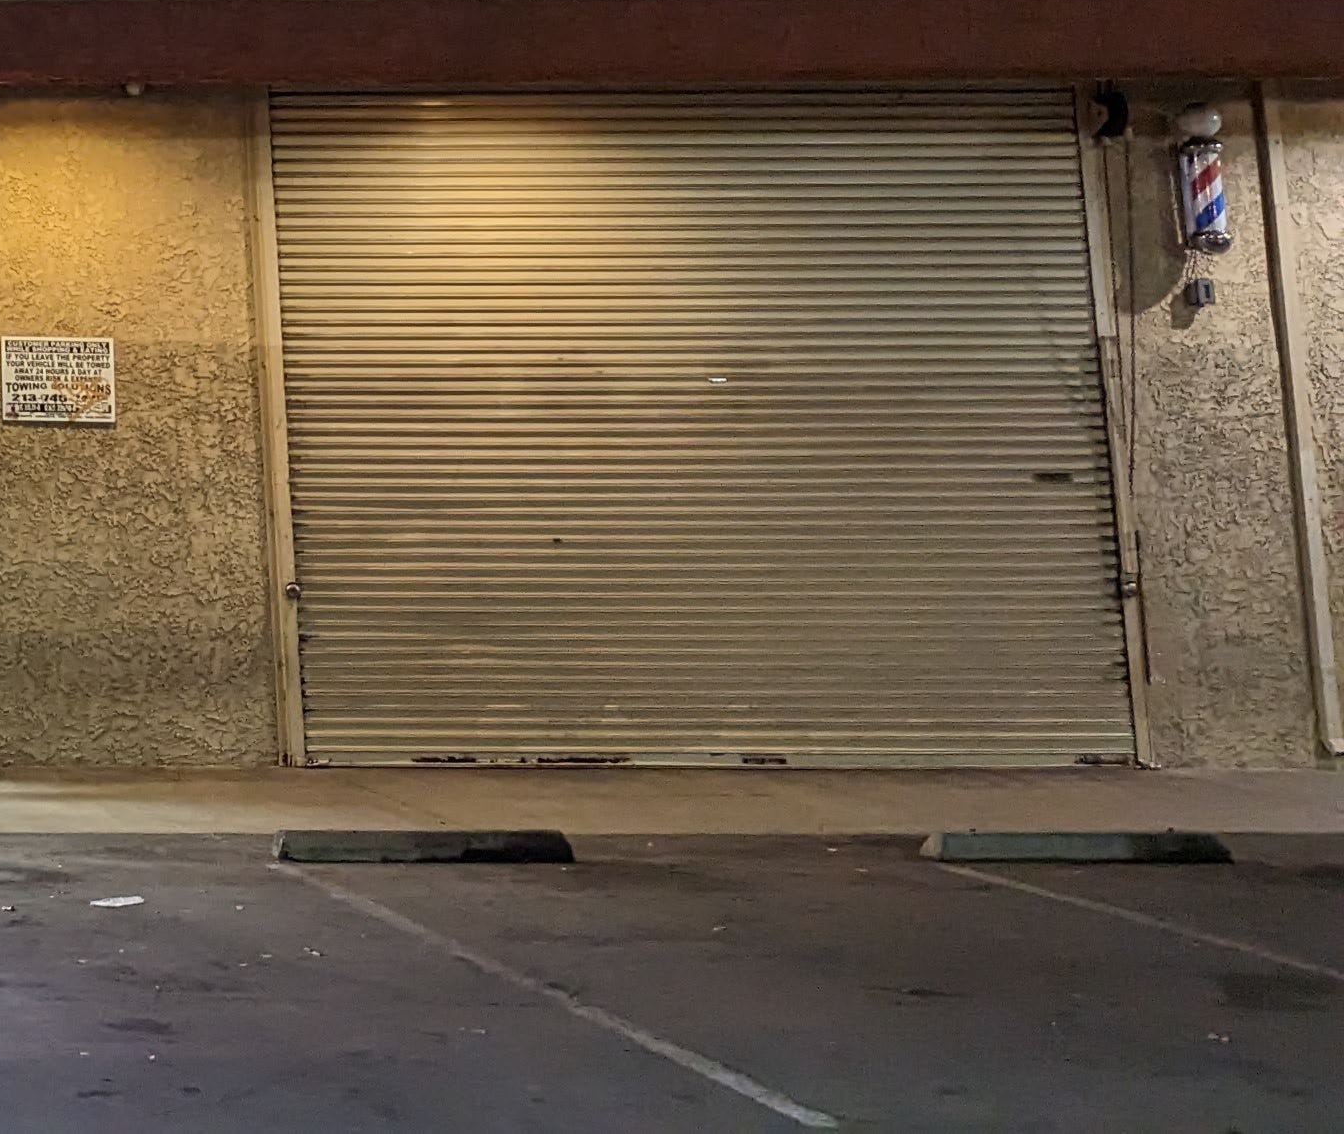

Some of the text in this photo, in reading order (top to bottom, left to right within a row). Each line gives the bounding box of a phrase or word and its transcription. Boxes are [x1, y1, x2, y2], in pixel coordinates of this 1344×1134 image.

[57, 354, 70, 362] THE
[73, 354, 110, 363] PROPERTY
[6, 382, 48, 393] TOWING
